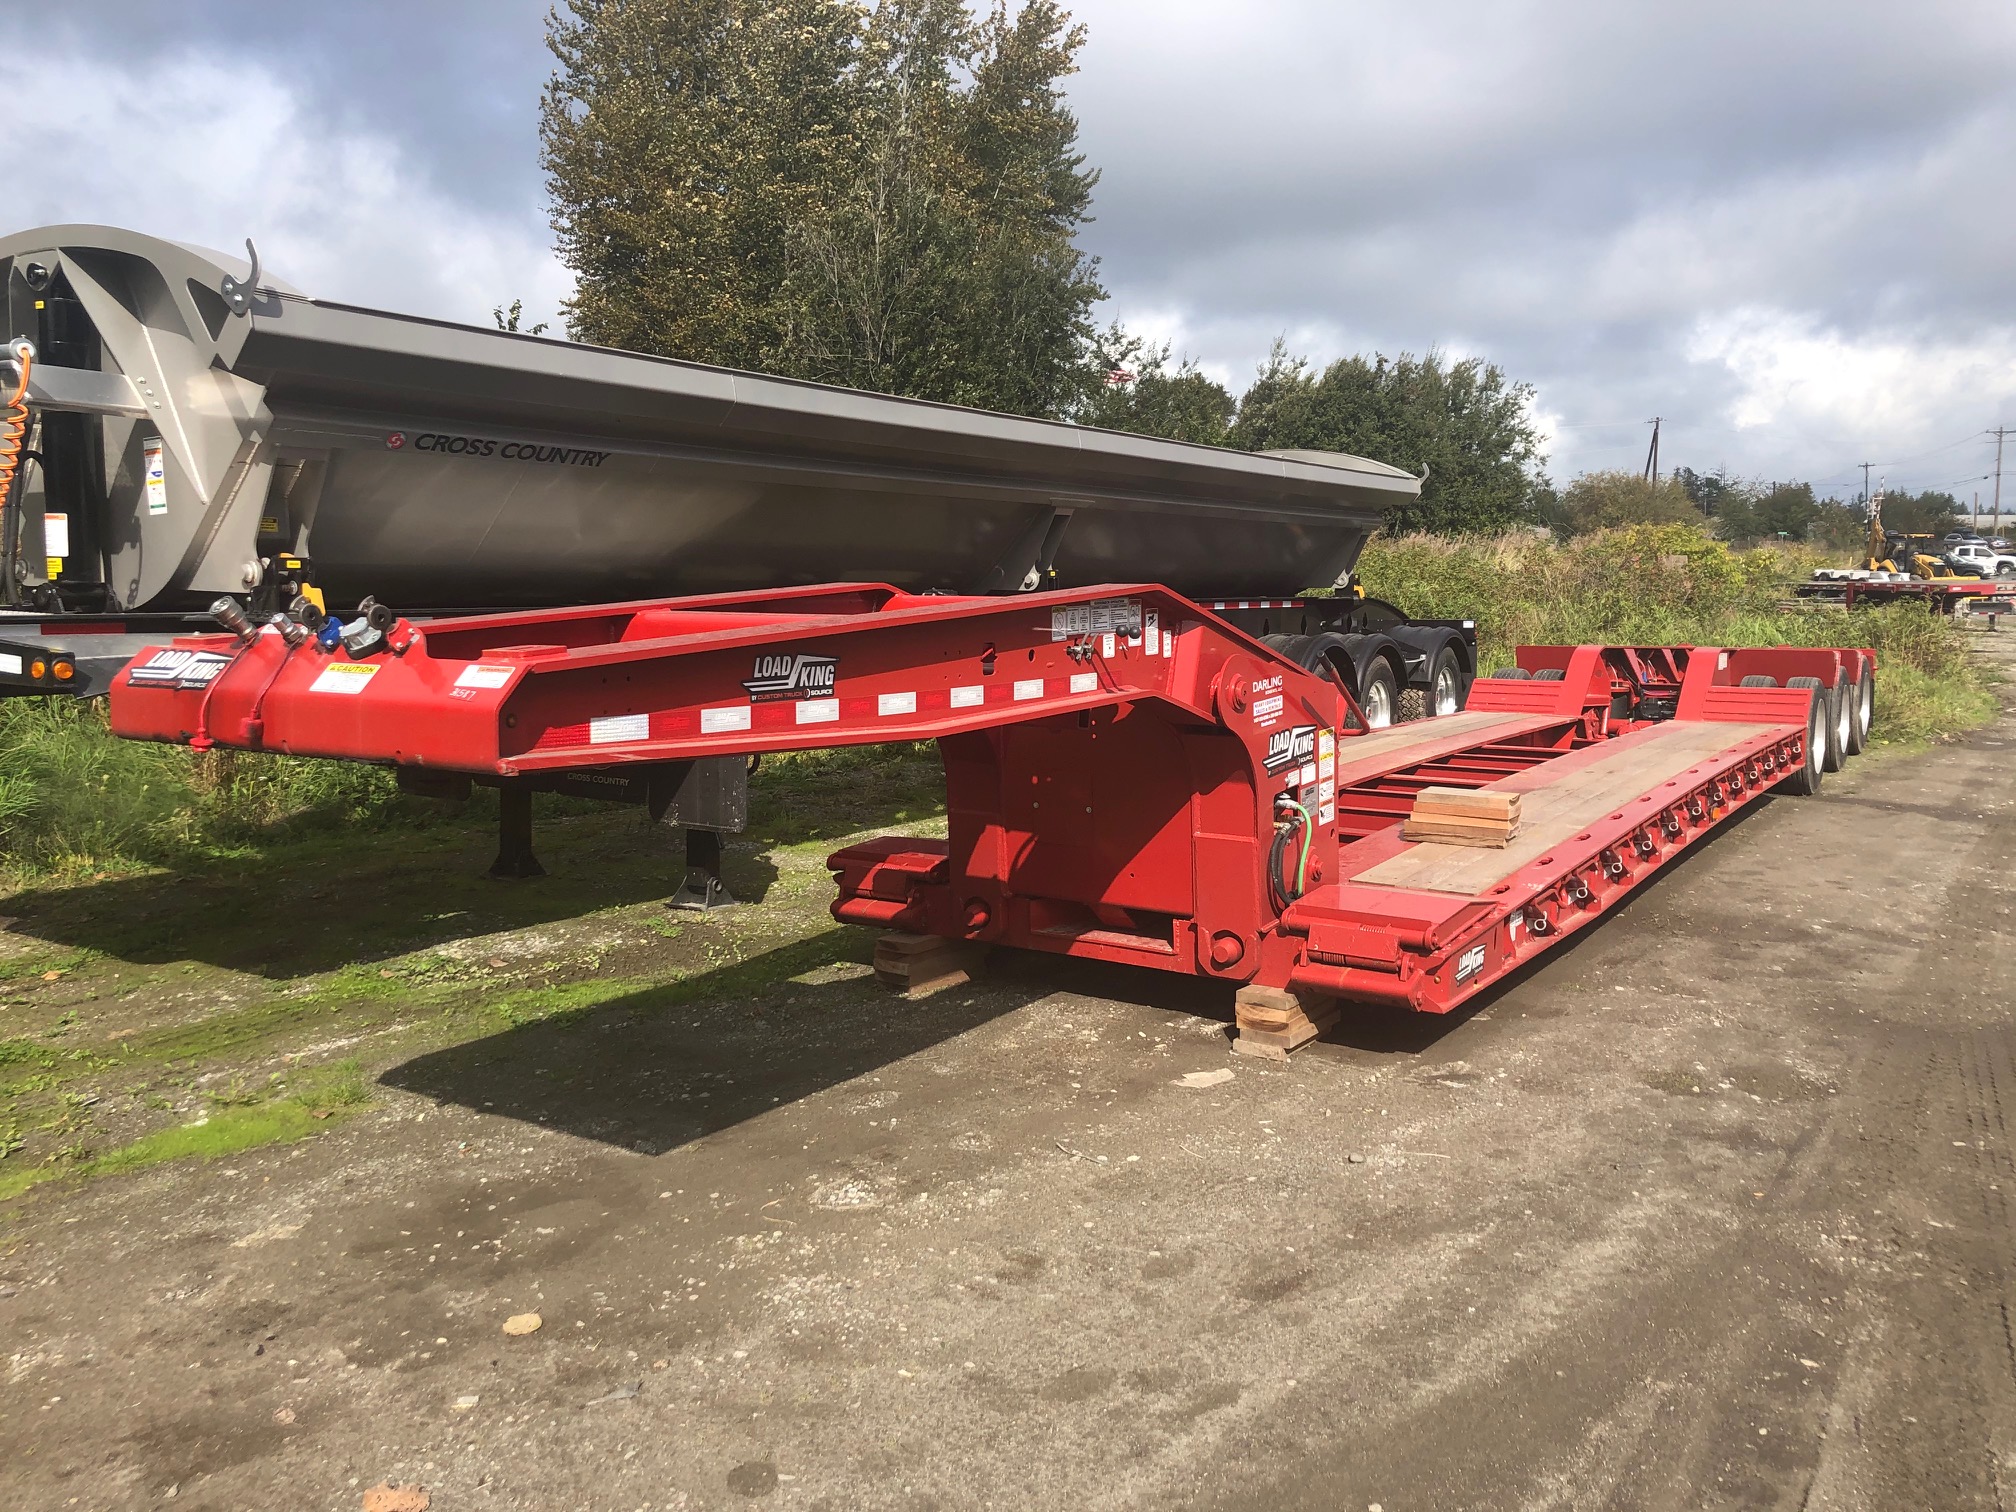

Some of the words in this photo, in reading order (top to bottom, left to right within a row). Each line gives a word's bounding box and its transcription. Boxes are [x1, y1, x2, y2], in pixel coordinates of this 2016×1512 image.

[414, 433, 498, 457] CROSS
[500, 442, 611, 467] COUNTRY
[145, 650, 192, 668] LOAD
[177, 662, 226, 680] KING
[336, 665, 376, 673] CAUTION
[754, 656, 792, 678] LOAD
[800, 665, 834, 687] KING
[758, 692, 783, 700] CUSTOM
[810, 688, 833, 696] SOURCE
[1252, 675, 1283, 693] DARLING
[1269, 730, 1290, 755] LOAD
[1294, 733, 1315, 757] KING
[567, 772, 591, 782] CROSS
[592, 775, 630, 786] COUNTRY
